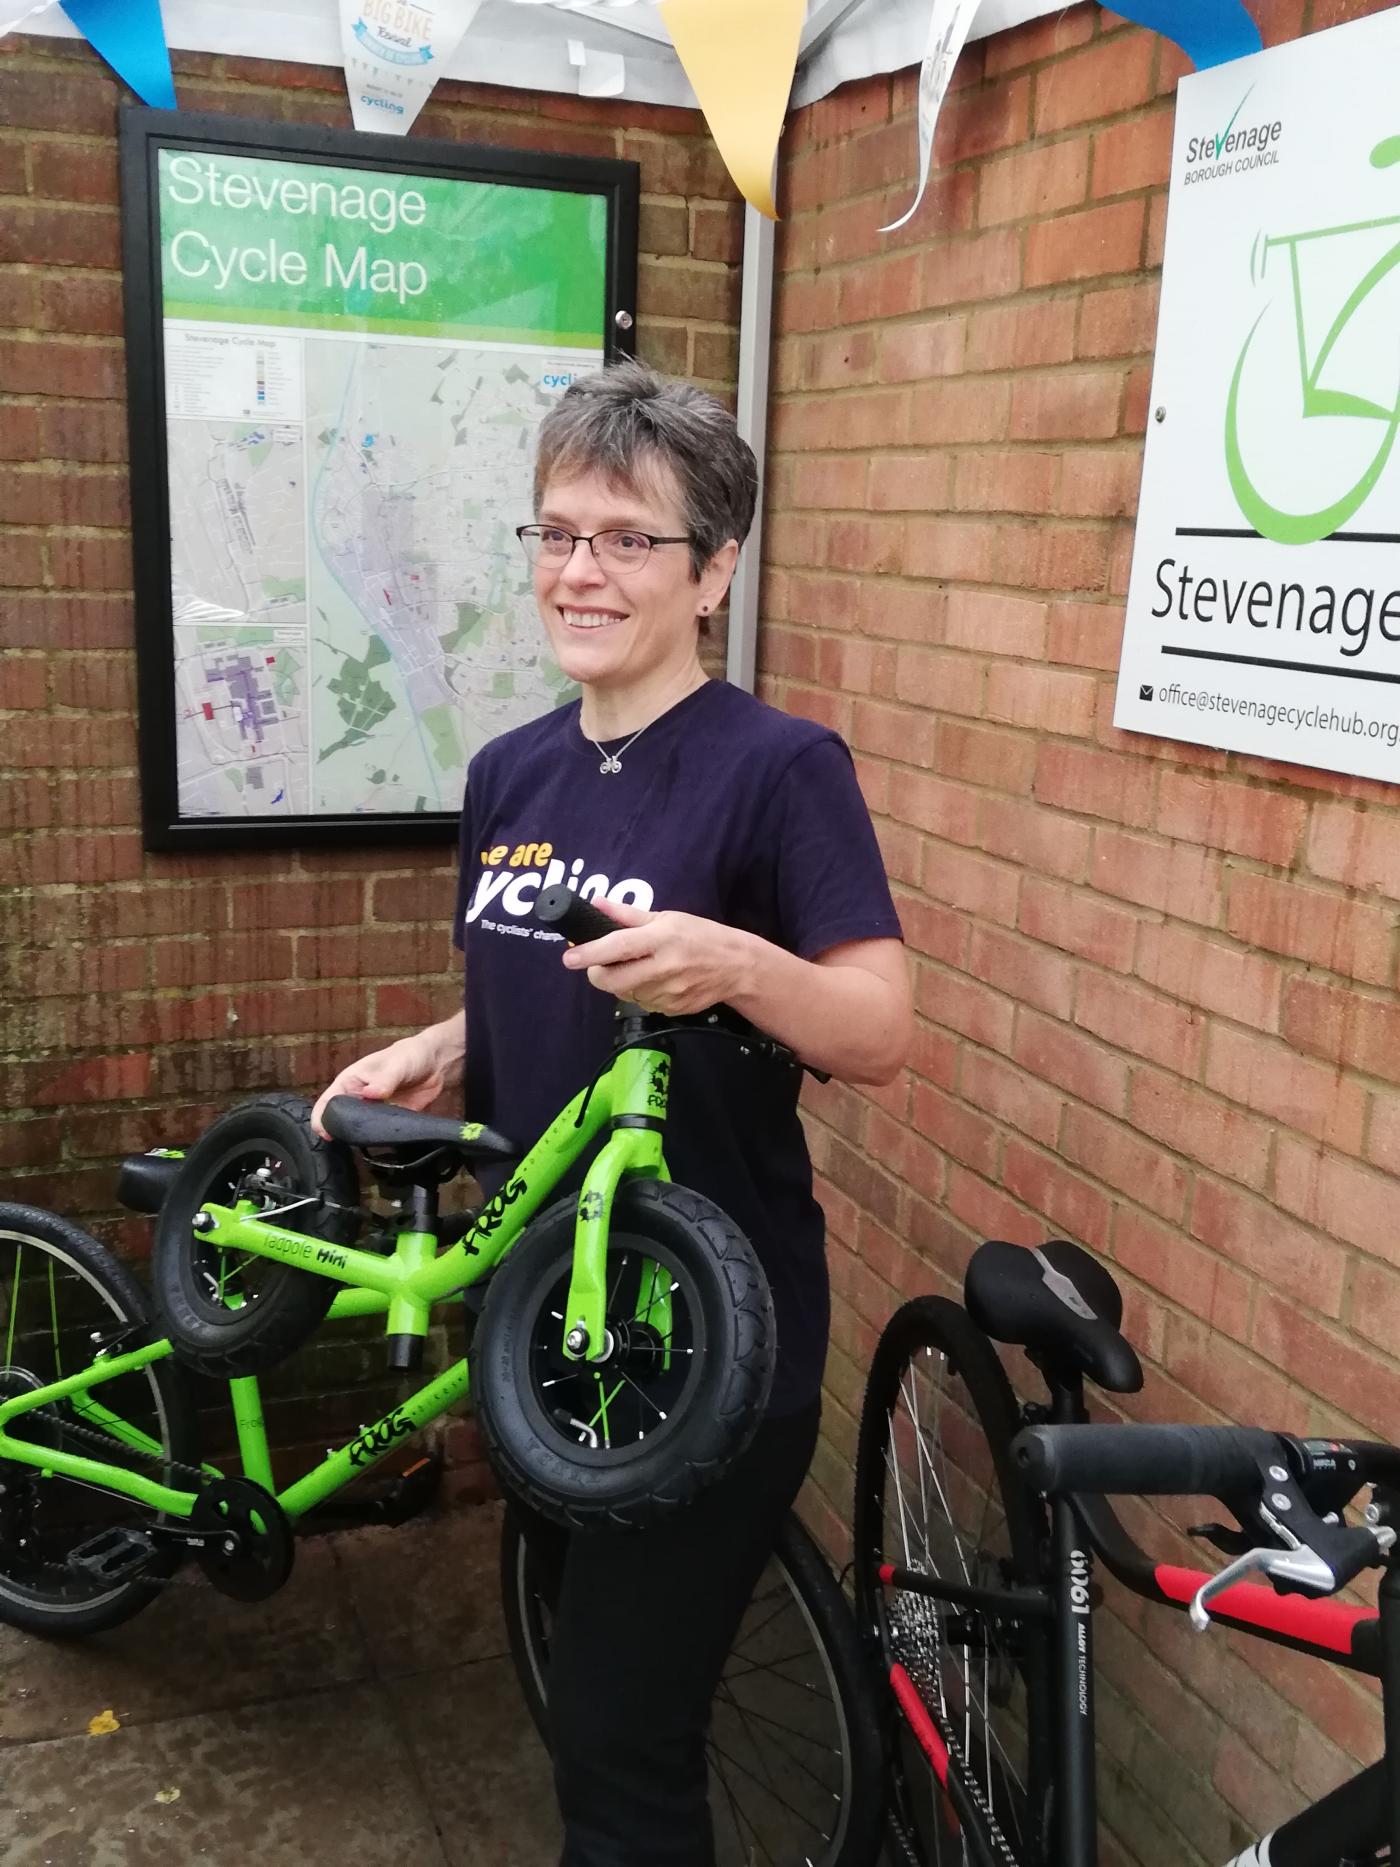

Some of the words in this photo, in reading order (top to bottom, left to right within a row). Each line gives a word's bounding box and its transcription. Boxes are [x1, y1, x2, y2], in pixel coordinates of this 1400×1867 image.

[393, 4, 433, 41] BIKE
[360, 95, 404, 114] cycling
[1186, 107, 1282, 163] Stevenage
[168, 156, 427, 234] Stevenage
[1184, 161, 1233, 186] BOROUGH
[1234, 150, 1279, 174] COUNCIL
[170, 230, 308, 290] Cycle
[324, 243, 428, 304] Map
[543, 373, 577, 388] cycli
[1151, 558, 1400, 657] Stevenage
[1158, 683, 1400, 747] office@stevenagecyclehub.org
[509, 842, 553, 867] are
[481, 919, 496, 931] The
[463, 1176, 528, 1256] FROG
[350, 1407, 417, 1466] FROG
[1077, 1655, 1089, 1716] TECHNOLOGY
